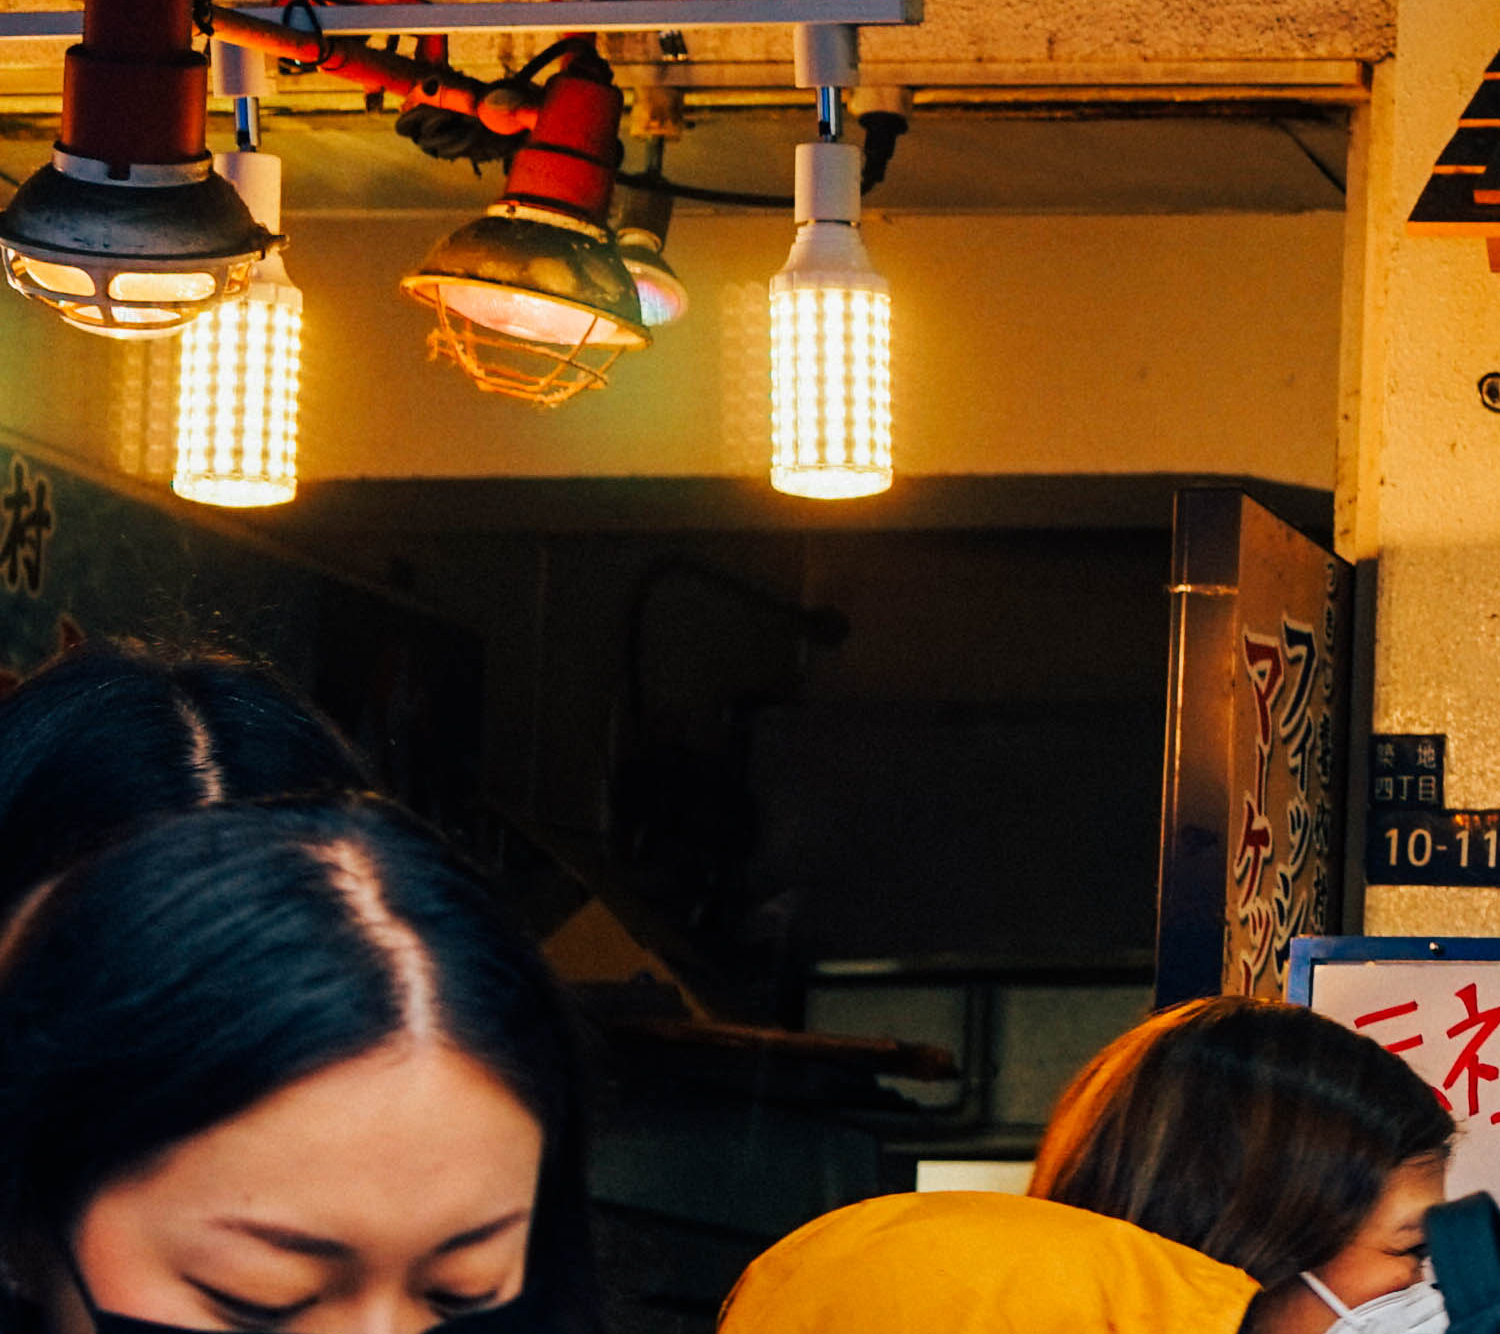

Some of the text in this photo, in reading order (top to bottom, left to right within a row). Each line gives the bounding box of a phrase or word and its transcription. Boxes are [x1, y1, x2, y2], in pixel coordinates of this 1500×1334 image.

[1375, 774, 1438, 802] 四丁目
[1384, 827, 1498, 869] 10-11
